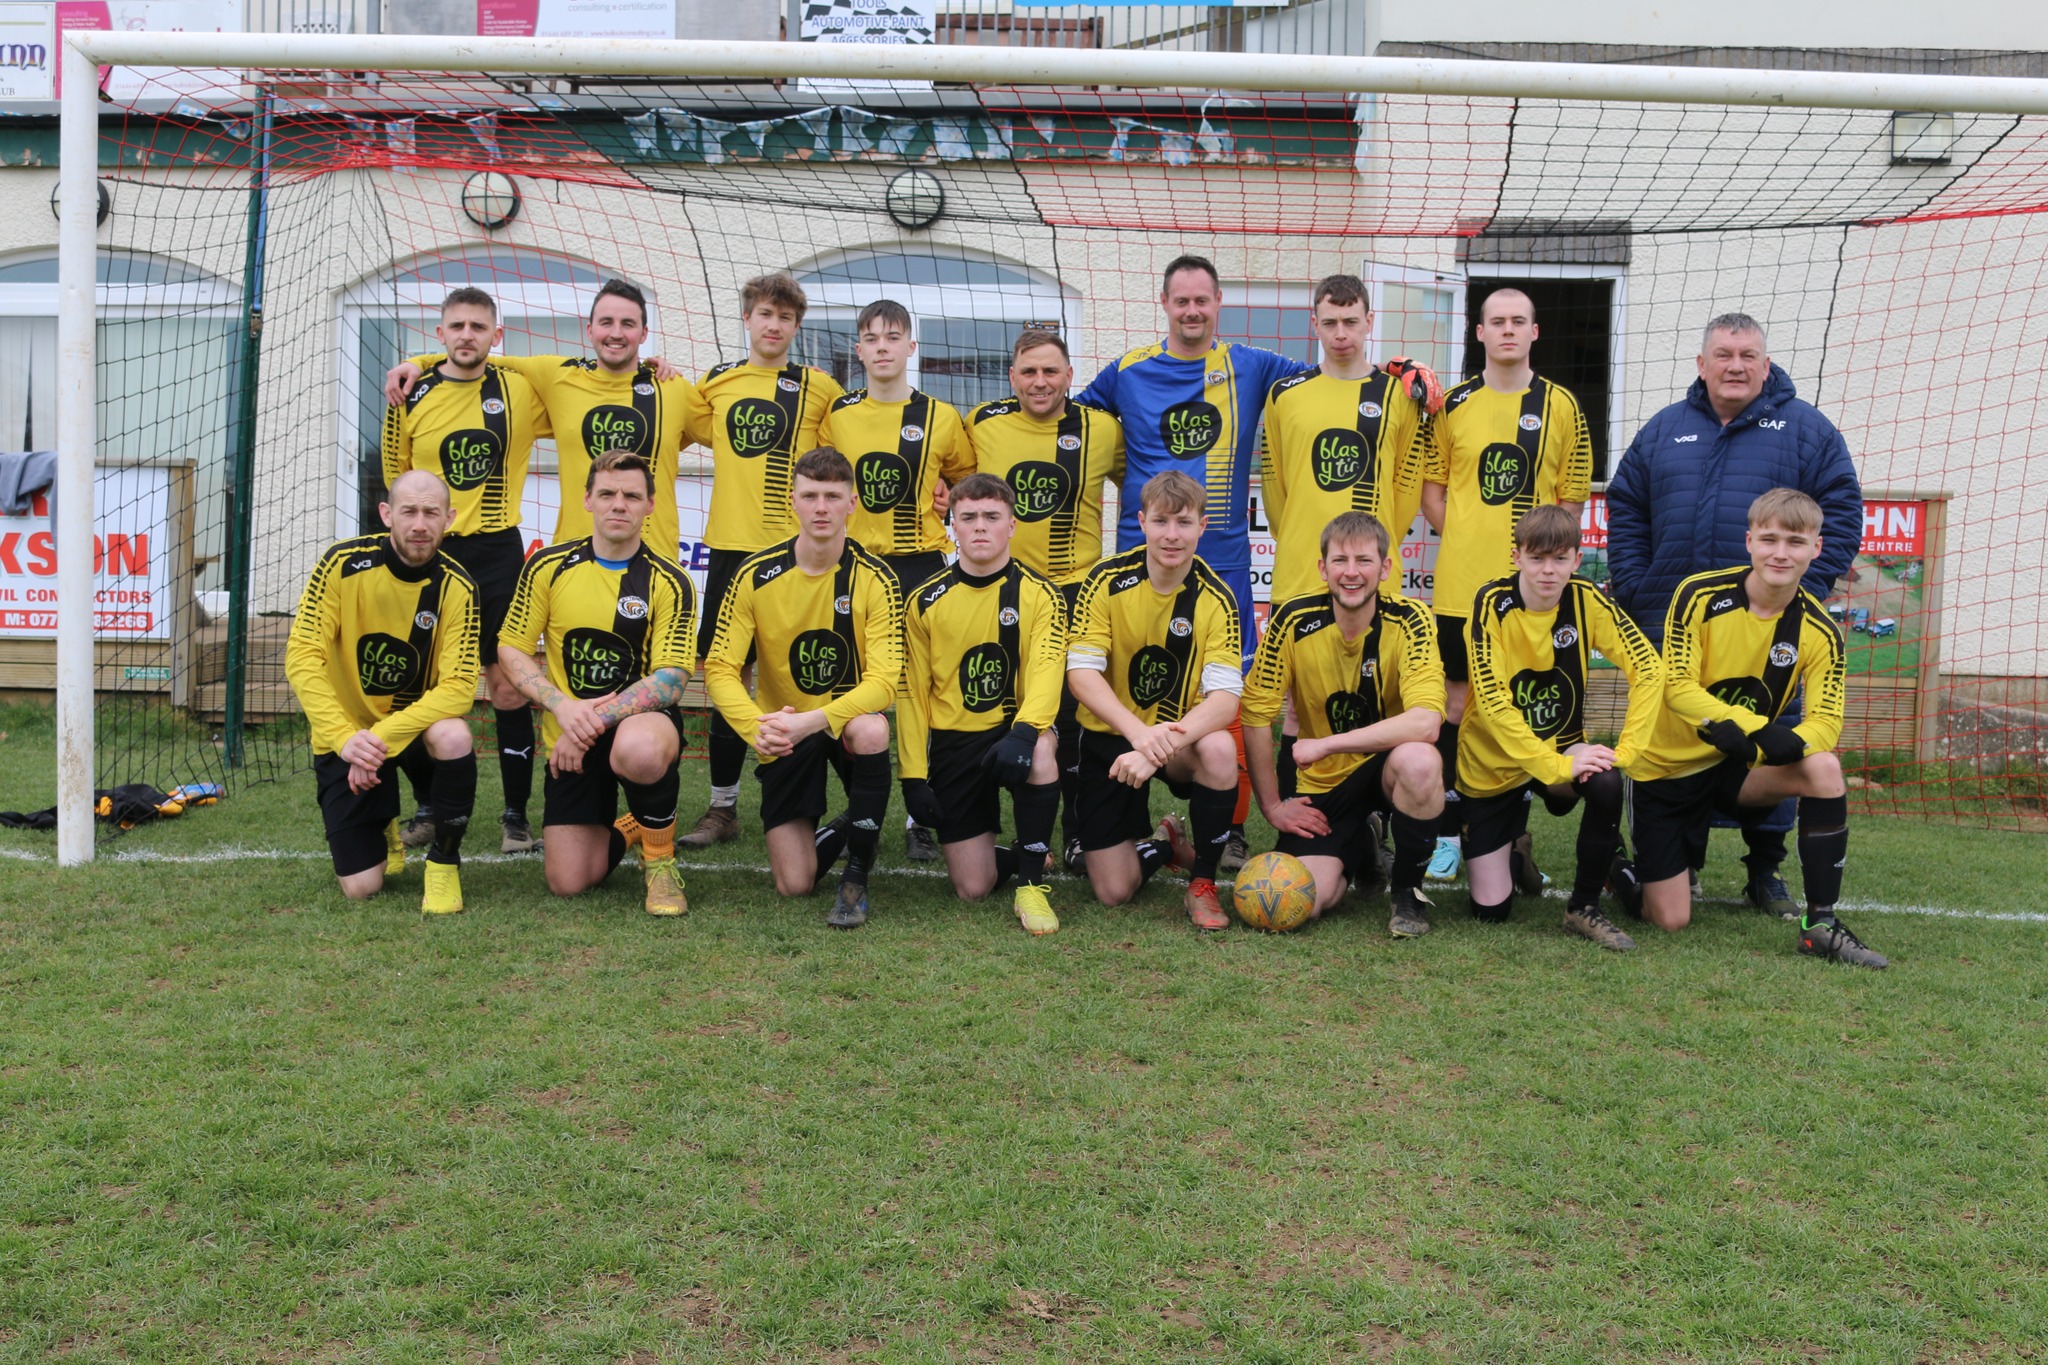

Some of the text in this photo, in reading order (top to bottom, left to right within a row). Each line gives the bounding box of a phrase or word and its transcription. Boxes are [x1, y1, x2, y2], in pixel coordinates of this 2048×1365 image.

[568, 1, 667, 13] consulting certification
[851, 0, 887, 8] TOOLS
[812, 16, 925, 27] AUTOMOTIVE PAINT
[592, 412, 635, 433] blas
[734, 405, 776, 427] blas
[1169, 409, 1211, 432] blas
[1758, 417, 1786, 430] GAF
[449, 437, 490, 461] blas
[733, 425, 774, 451] y tir
[1170, 428, 1212, 455] y tir
[1320, 436, 1359, 459] blas
[449, 455, 490, 485] y tir
[862, 460, 900, 482] blas
[1318, 457, 1358, 486] y tir
[1486, 451, 1519, 473] blas
[1015, 468, 1058, 490] blas
[1482, 471, 1519, 499] y tir
[863, 481, 899, 507] y tir
[1014, 486, 1057, 516] y tir
[1861, 506, 1917, 538] HN
[1858, 541, 1914, 552] CENTRE
[5, 613, 25, 626] M:
[364, 641, 407, 669] blas
[571, 638, 620, 662] blas
[799, 639, 837, 664] blas
[361, 663, 405, 689] y tir
[570, 661, 619, 691] y tir
[800, 660, 837, 689] y tir
[968, 652, 1002, 679] blas
[965, 680, 978, 706] y
[1517, 680, 1560, 706] blas
[1534, 700, 1561, 725] tir
